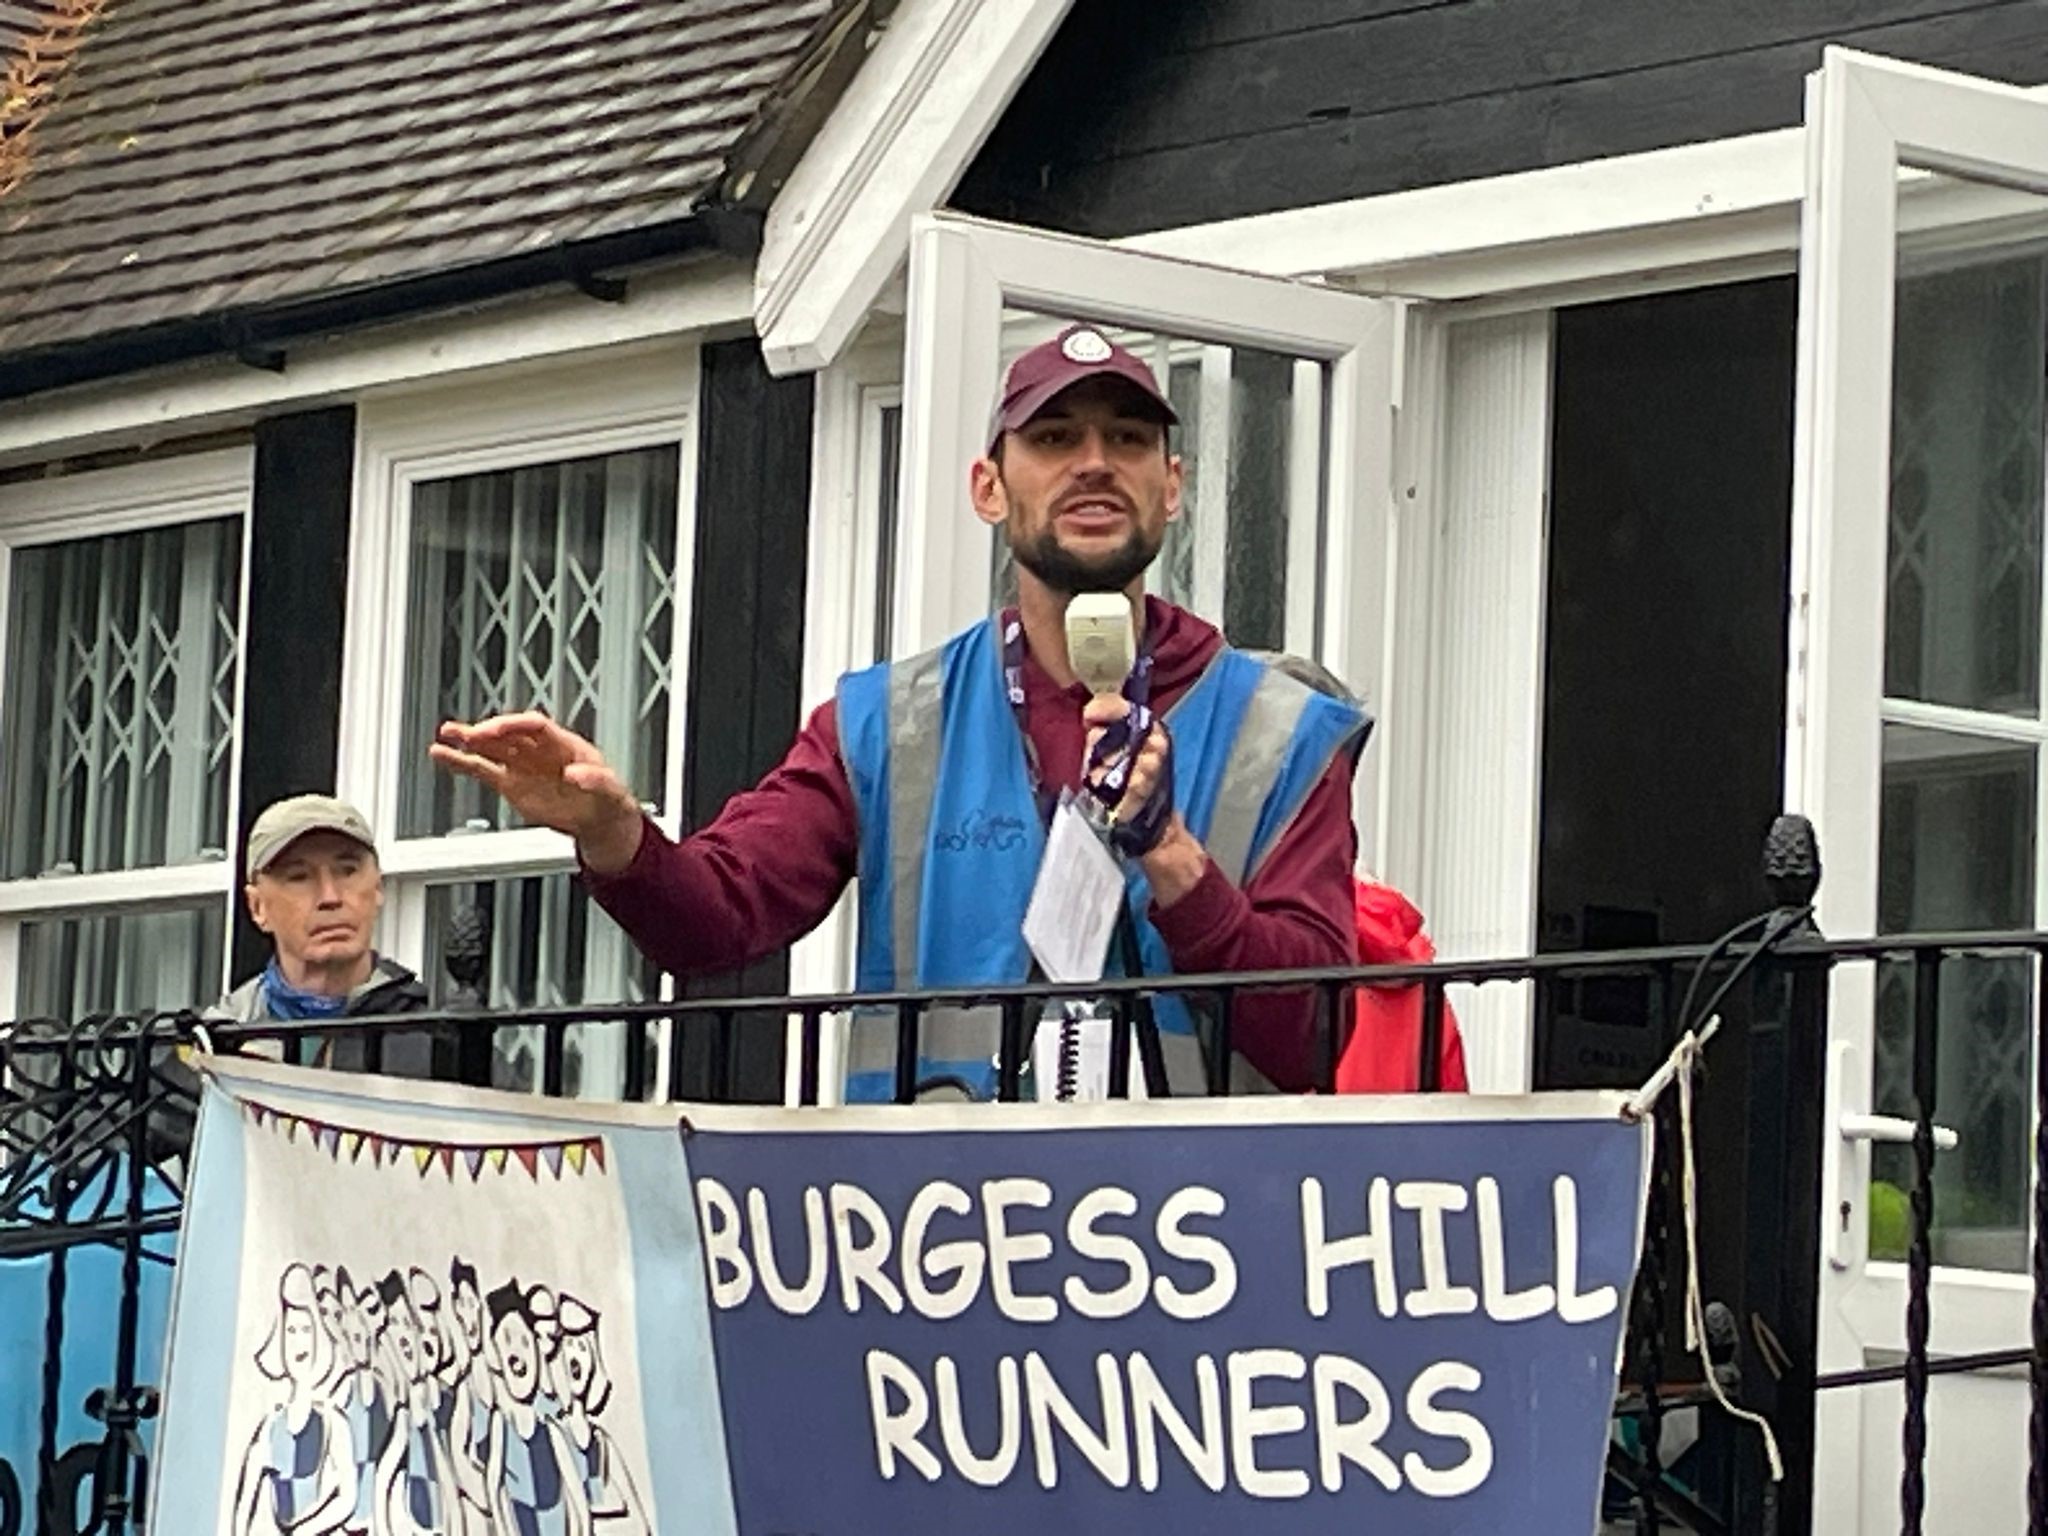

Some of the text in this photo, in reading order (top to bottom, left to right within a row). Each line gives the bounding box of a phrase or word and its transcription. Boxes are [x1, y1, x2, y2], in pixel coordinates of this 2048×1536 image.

[696, 1174, 1618, 1324] BURGESS HILL
[866, 1348, 1494, 1498] RUNNERS
